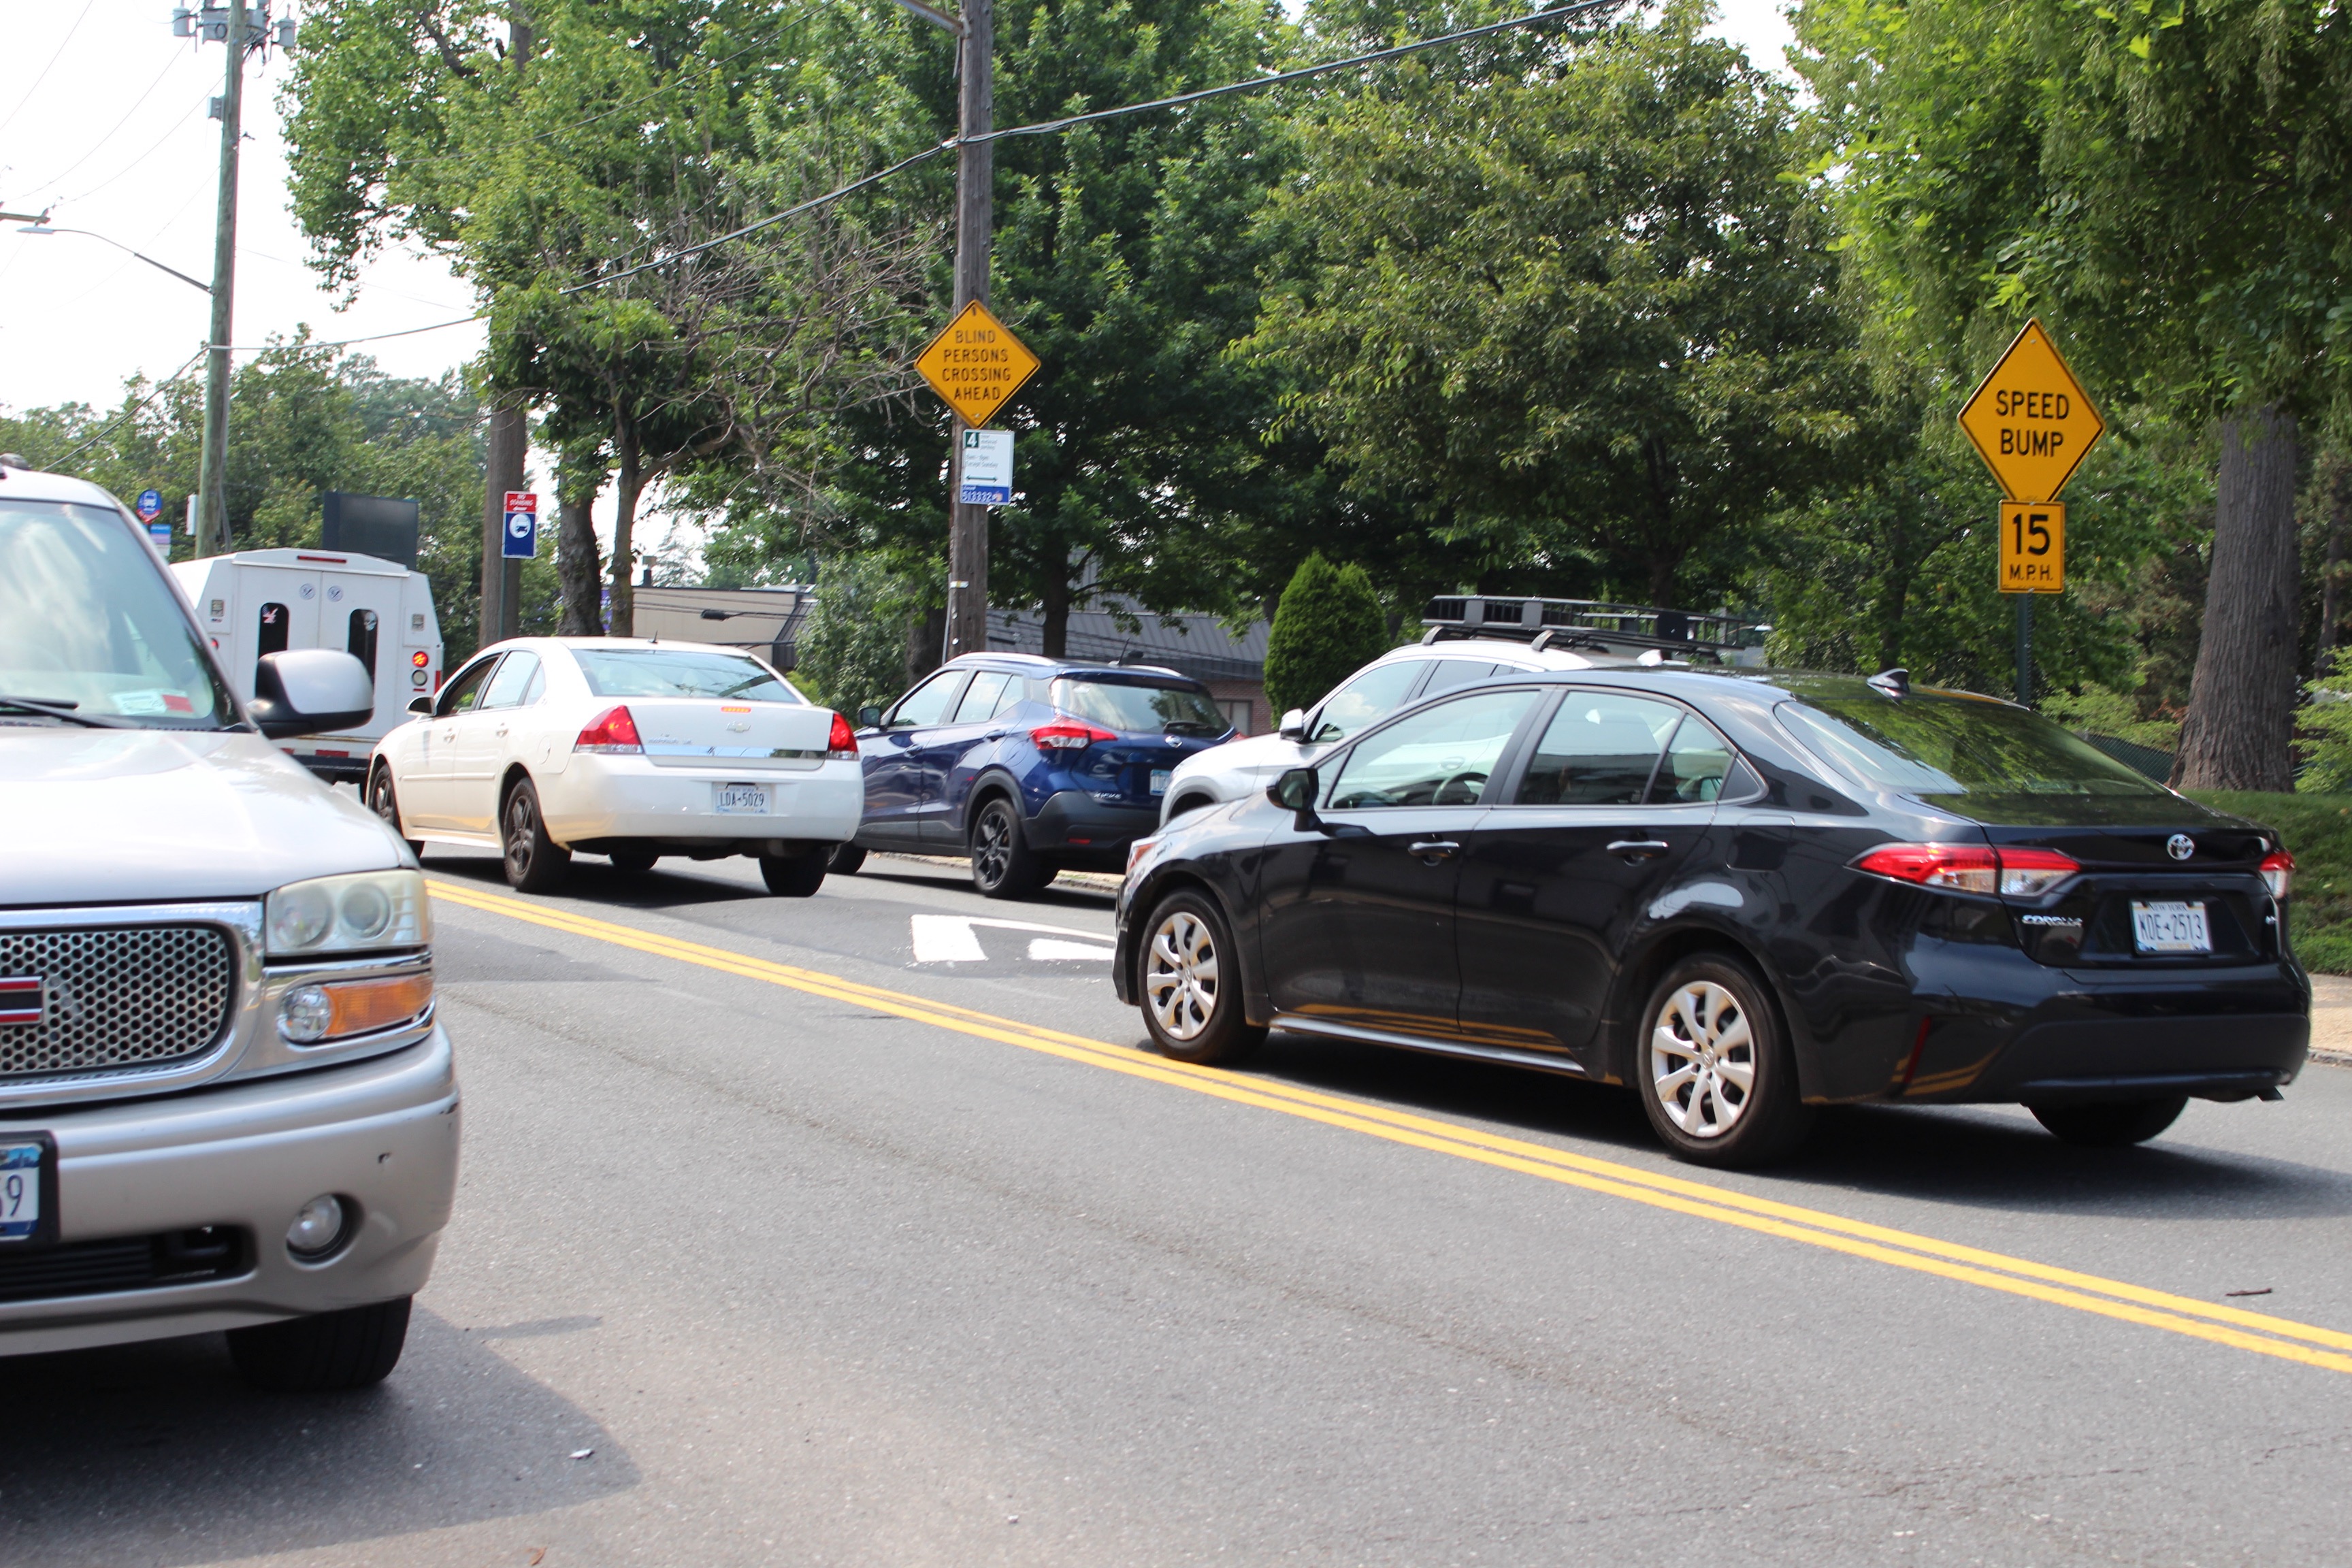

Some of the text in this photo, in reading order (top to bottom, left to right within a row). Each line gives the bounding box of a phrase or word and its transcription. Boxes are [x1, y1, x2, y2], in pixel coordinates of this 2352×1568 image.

[955, 329, 996, 344] BLIND
[943, 348, 1009, 363] PERSONS
[942, 368, 1011, 382] CROSSING
[953, 387, 1001, 401] AHEAD
[1995, 389, 2070, 421] SPEED
[966, 432, 977, 447] 4
[2000, 428, 2064, 458] BUMP
[2012, 512, 2051, 556] 15
[2008, 564, 2053, 581] M.P.H.
